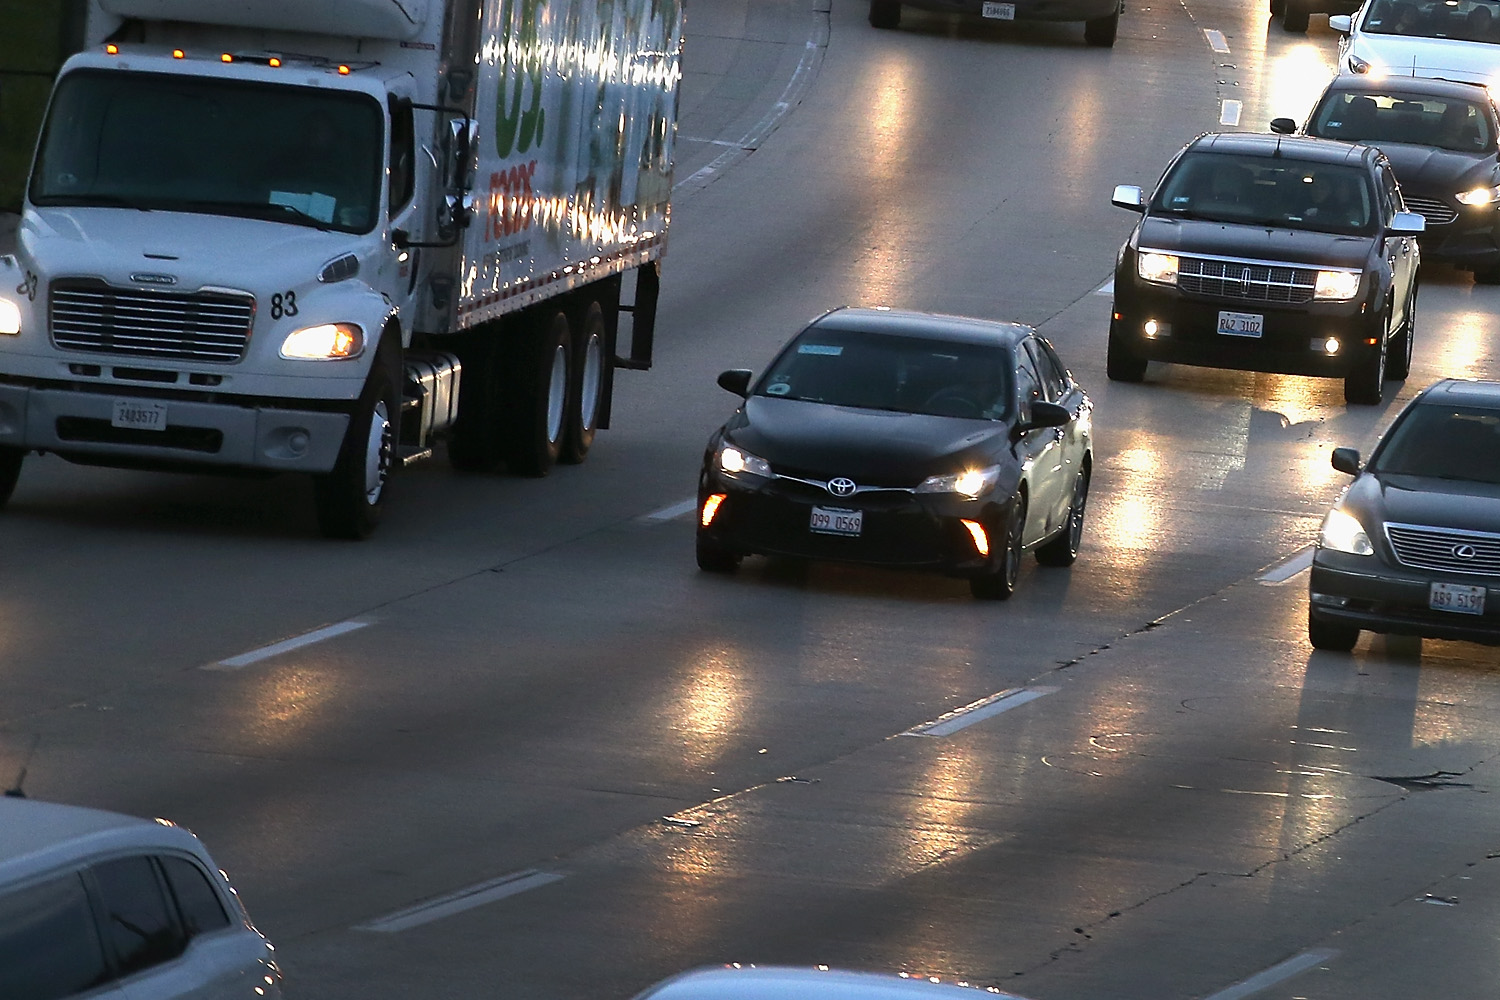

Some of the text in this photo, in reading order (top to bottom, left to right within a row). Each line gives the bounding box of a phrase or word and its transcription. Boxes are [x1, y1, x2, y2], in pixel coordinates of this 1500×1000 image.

[270, 291, 299, 320] 83
[1220, 318, 1261, 334] R42 3102
[835, 516, 861, 531] 0569
